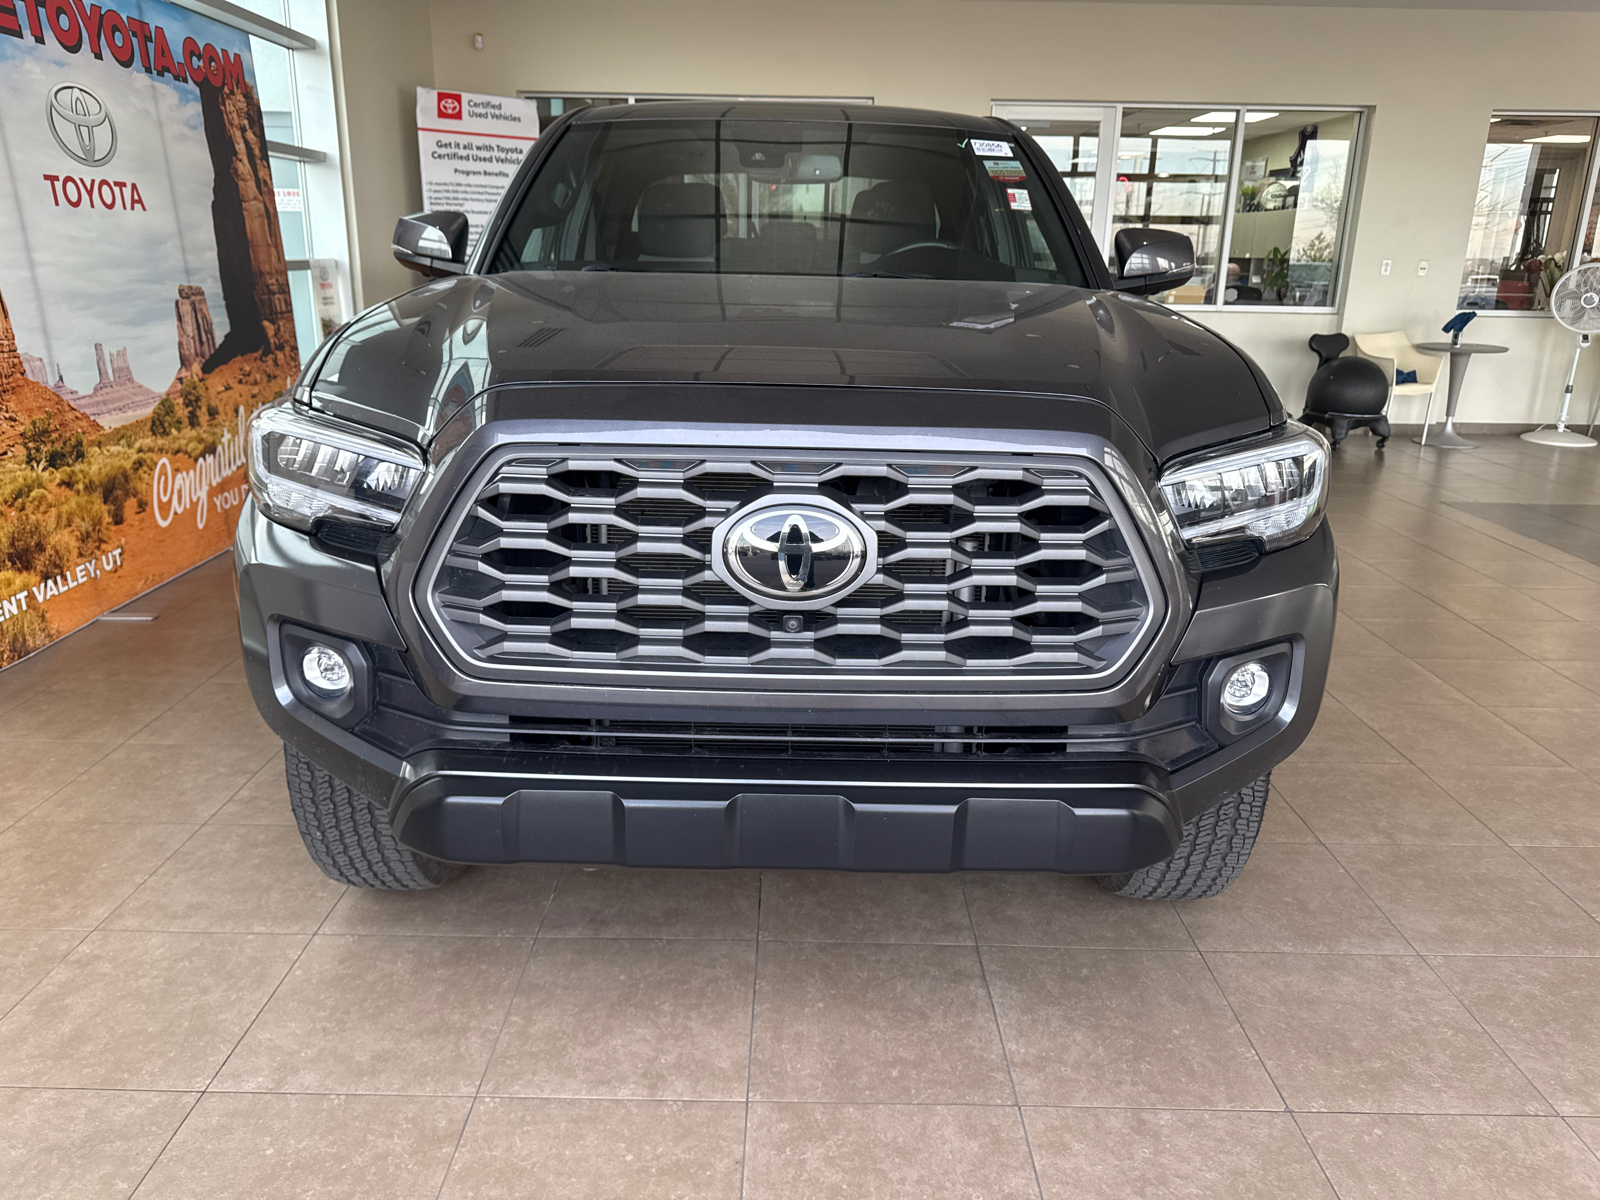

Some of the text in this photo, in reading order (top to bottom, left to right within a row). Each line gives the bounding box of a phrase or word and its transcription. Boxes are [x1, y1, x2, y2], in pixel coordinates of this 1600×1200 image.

[467, 99, 502, 111] Certified
[467, 110, 521, 123] Used Vehicles
[436, 140, 523, 155] Get it all with Toyota
[431, 151, 471, 162] Certified
[471, 153, 494, 164] Used
[454, 168, 510, 178] Program Benefits
[43, 174, 147, 212] TOYOTA
[213, 487, 239, 513] YOU
[31, 558, 102, 604] VALLEY,
[102, 547, 122, 572] UT
